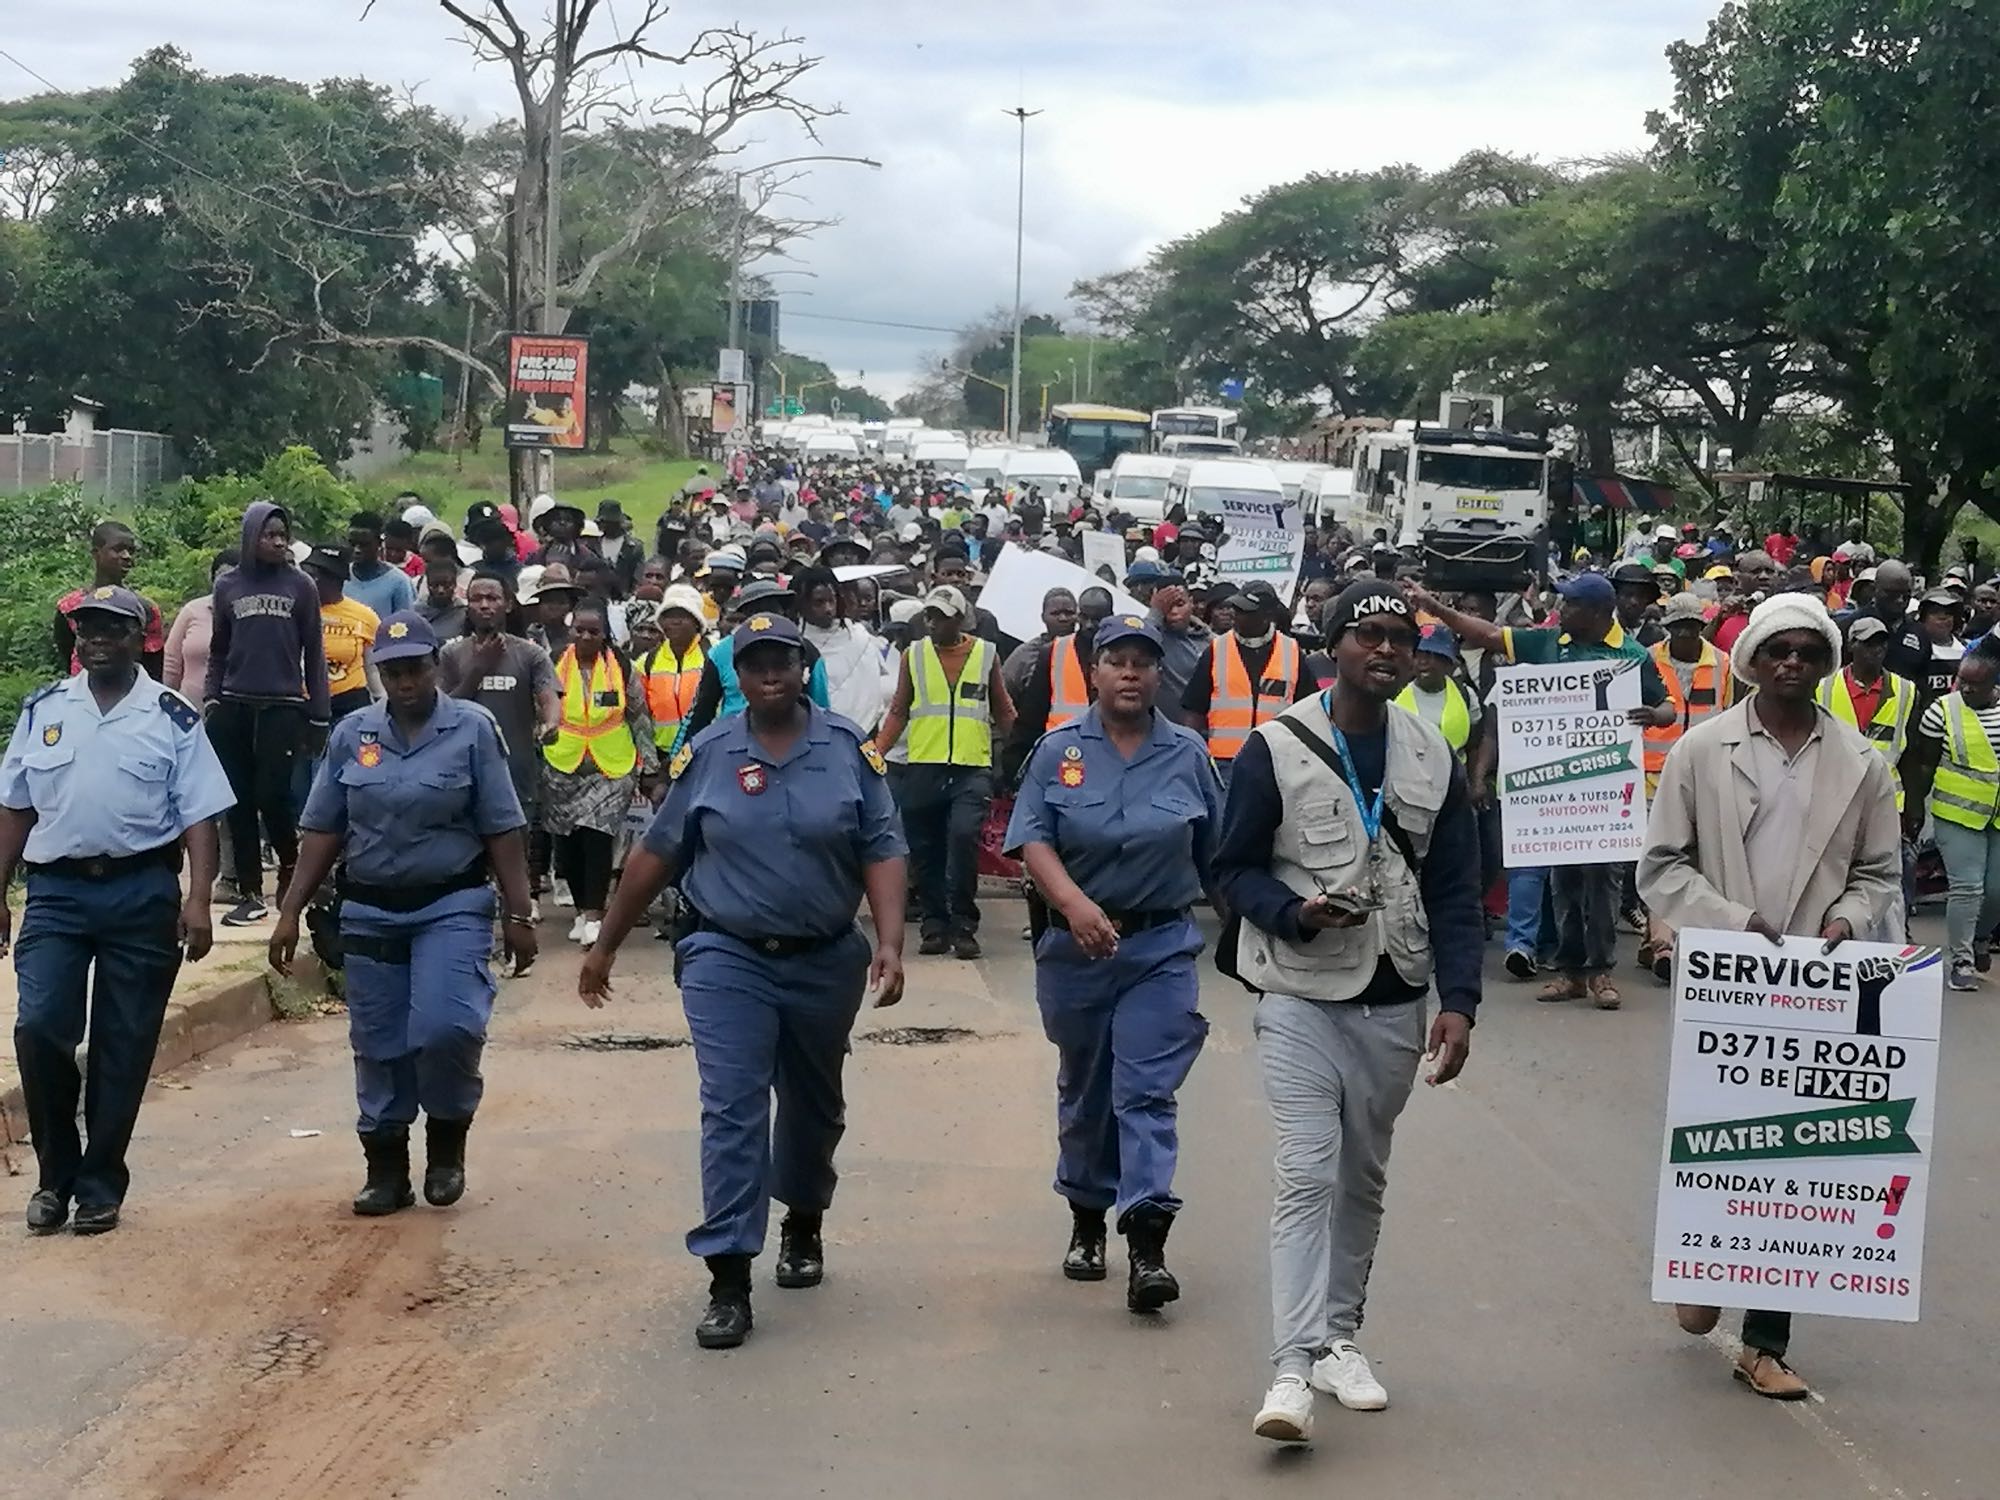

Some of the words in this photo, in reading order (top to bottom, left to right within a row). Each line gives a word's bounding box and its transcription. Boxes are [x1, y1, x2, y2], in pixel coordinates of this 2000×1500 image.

[520, 356, 577, 370] PRE-PAID
[1222, 499, 1273, 515] SERVICE
[1266, 529, 1294, 542] ROAD
[1221, 560, 1254, 572] WATER
[1255, 557, 1288, 569] CRISIS
[1353, 594, 1408, 619] KING
[1502, 674, 1590, 695] SERVICE
[1502, 697, 1546, 707] DELIVERY
[1548, 694, 1590, 705] PROTEST
[1511, 717, 1567, 734] D3715
[1574, 714, 1625, 730] ROAD
[1523, 736, 1543, 748] TO
[1547, 735, 1563, 747] BE
[1567, 731, 1618, 748] FIXED
[1511, 765, 1565, 788] WATER
[1568, 750, 1621, 775] CRISIS
[1509, 793, 1563, 806] MONDAY
[1568, 793, 1576, 802] &
[1539, 804, 1609, 818] SHUTDOWN
[1516, 828, 1529, 837] 22
[1542, 826, 1555, 836] 23
[1558, 823, 1605, 835] JANUARY
[1609, 822, 1634, 832] 2024
[1511, 839, 1594, 855] ELECTRICITY
[1598, 837, 1643, 850] CRISIS
[1688, 950, 1851, 991] SERVICE
[1685, 986, 1766, 1007] DELIVERY
[1770, 994, 1848, 1013] PROTEST
[1697, 1031, 1800, 1061] D3715
[1814, 1041, 1906, 1069] ROAD
[1717, 1064, 1750, 1085] TO
[1761, 1070, 1789, 1088] BE
[1796, 1069, 1889, 1101] FIXED
[1685, 1125, 1784, 1156] WATER
[1794, 1115, 1892, 1145] CRISIS
[1676, 1171, 1775, 1194] MONDAY
[1786, 1179, 1799, 1195] &
[1726, 1199, 1855, 1225] SHUTDOWN
[1681, 1232, 1703, 1248] 22
[1710, 1234, 1722, 1249] &
[1730, 1236, 1752, 1251] 23
[1758, 1238, 1846, 1259] JANUARY
[1851, 1245, 1897, 1263] 2024
[1668, 1260, 1820, 1289] ELECTRICITY
[1830, 1272, 1910, 1296] CRISIS
